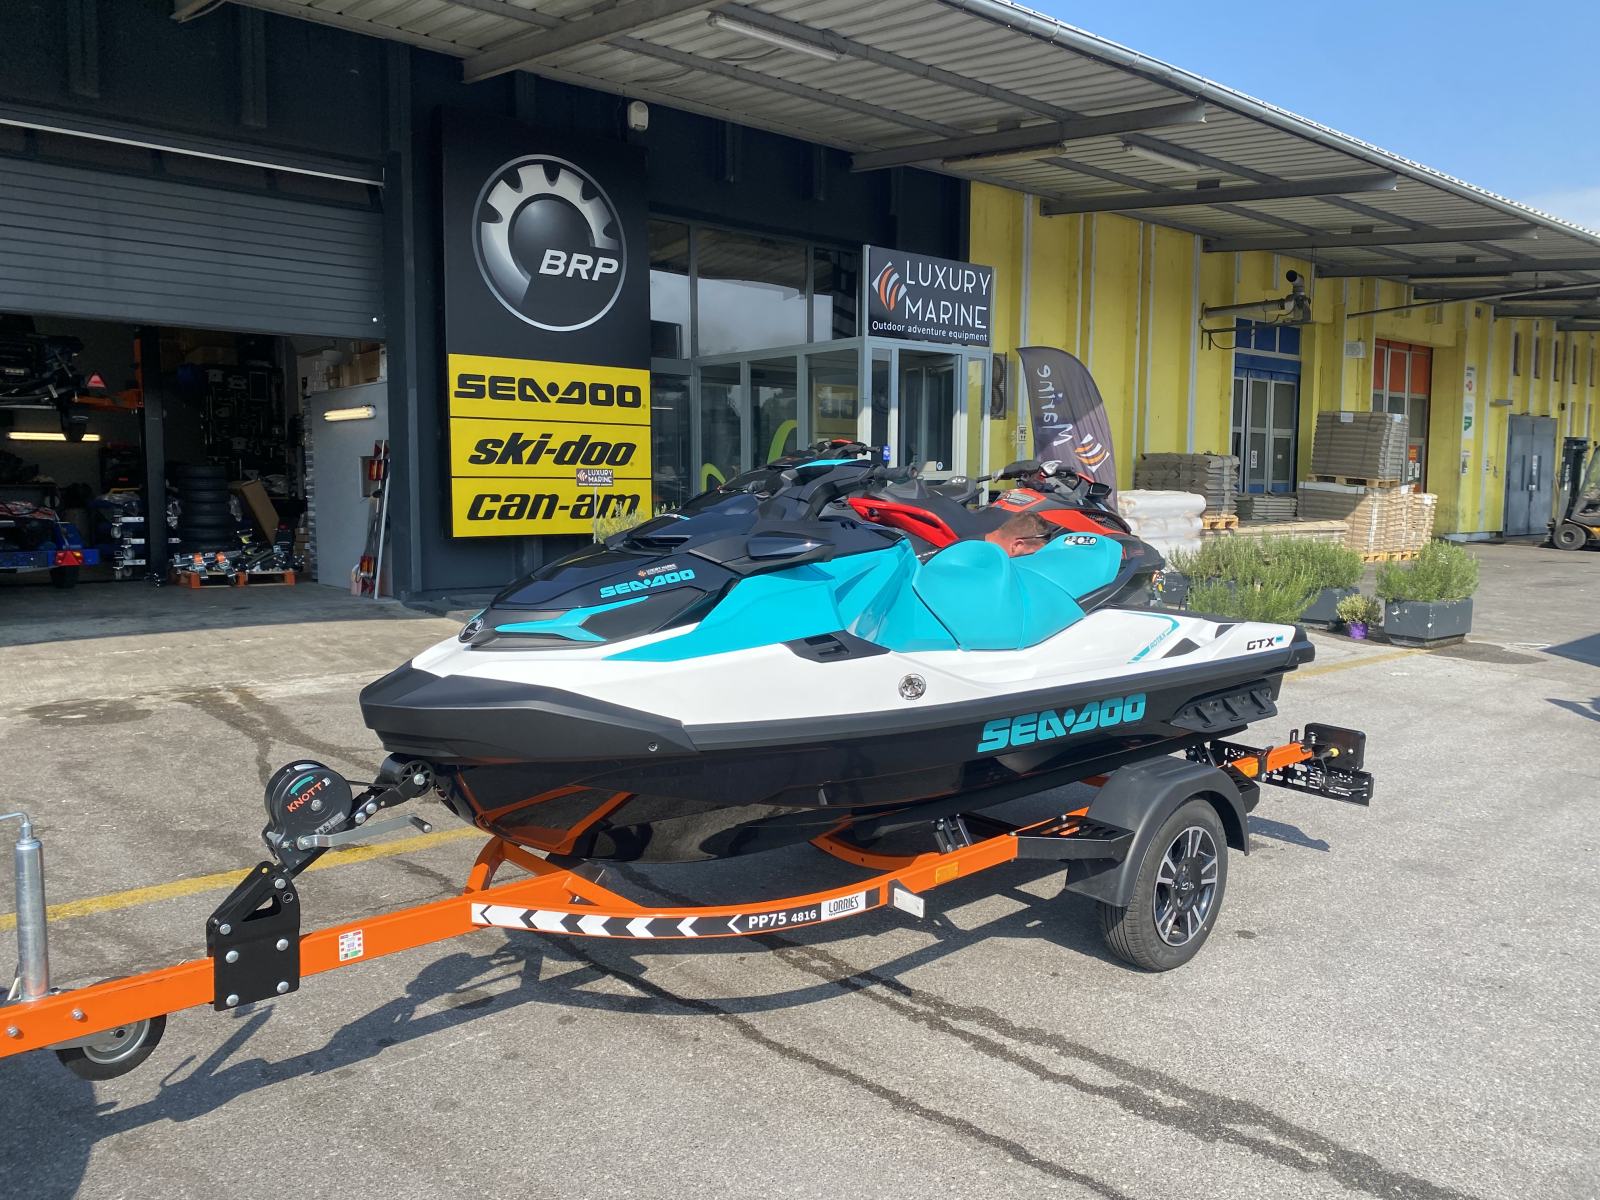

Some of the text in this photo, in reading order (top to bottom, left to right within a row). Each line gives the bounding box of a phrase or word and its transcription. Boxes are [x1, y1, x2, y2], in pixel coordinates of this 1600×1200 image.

[539, 249, 619, 281] BRP
[906, 260, 991, 295] LUXURY
[905, 295, 987, 329] MARINE
[872, 320, 988, 341] Outdoor adventure equipment
[468, 432, 637, 467] ski-doo
[467, 493, 641, 521] can-am
[1246, 636, 1275, 651] GTX
[286, 781, 323, 812] KNOTT
[748, 895, 859, 929] PP75 4816 LORRIES
